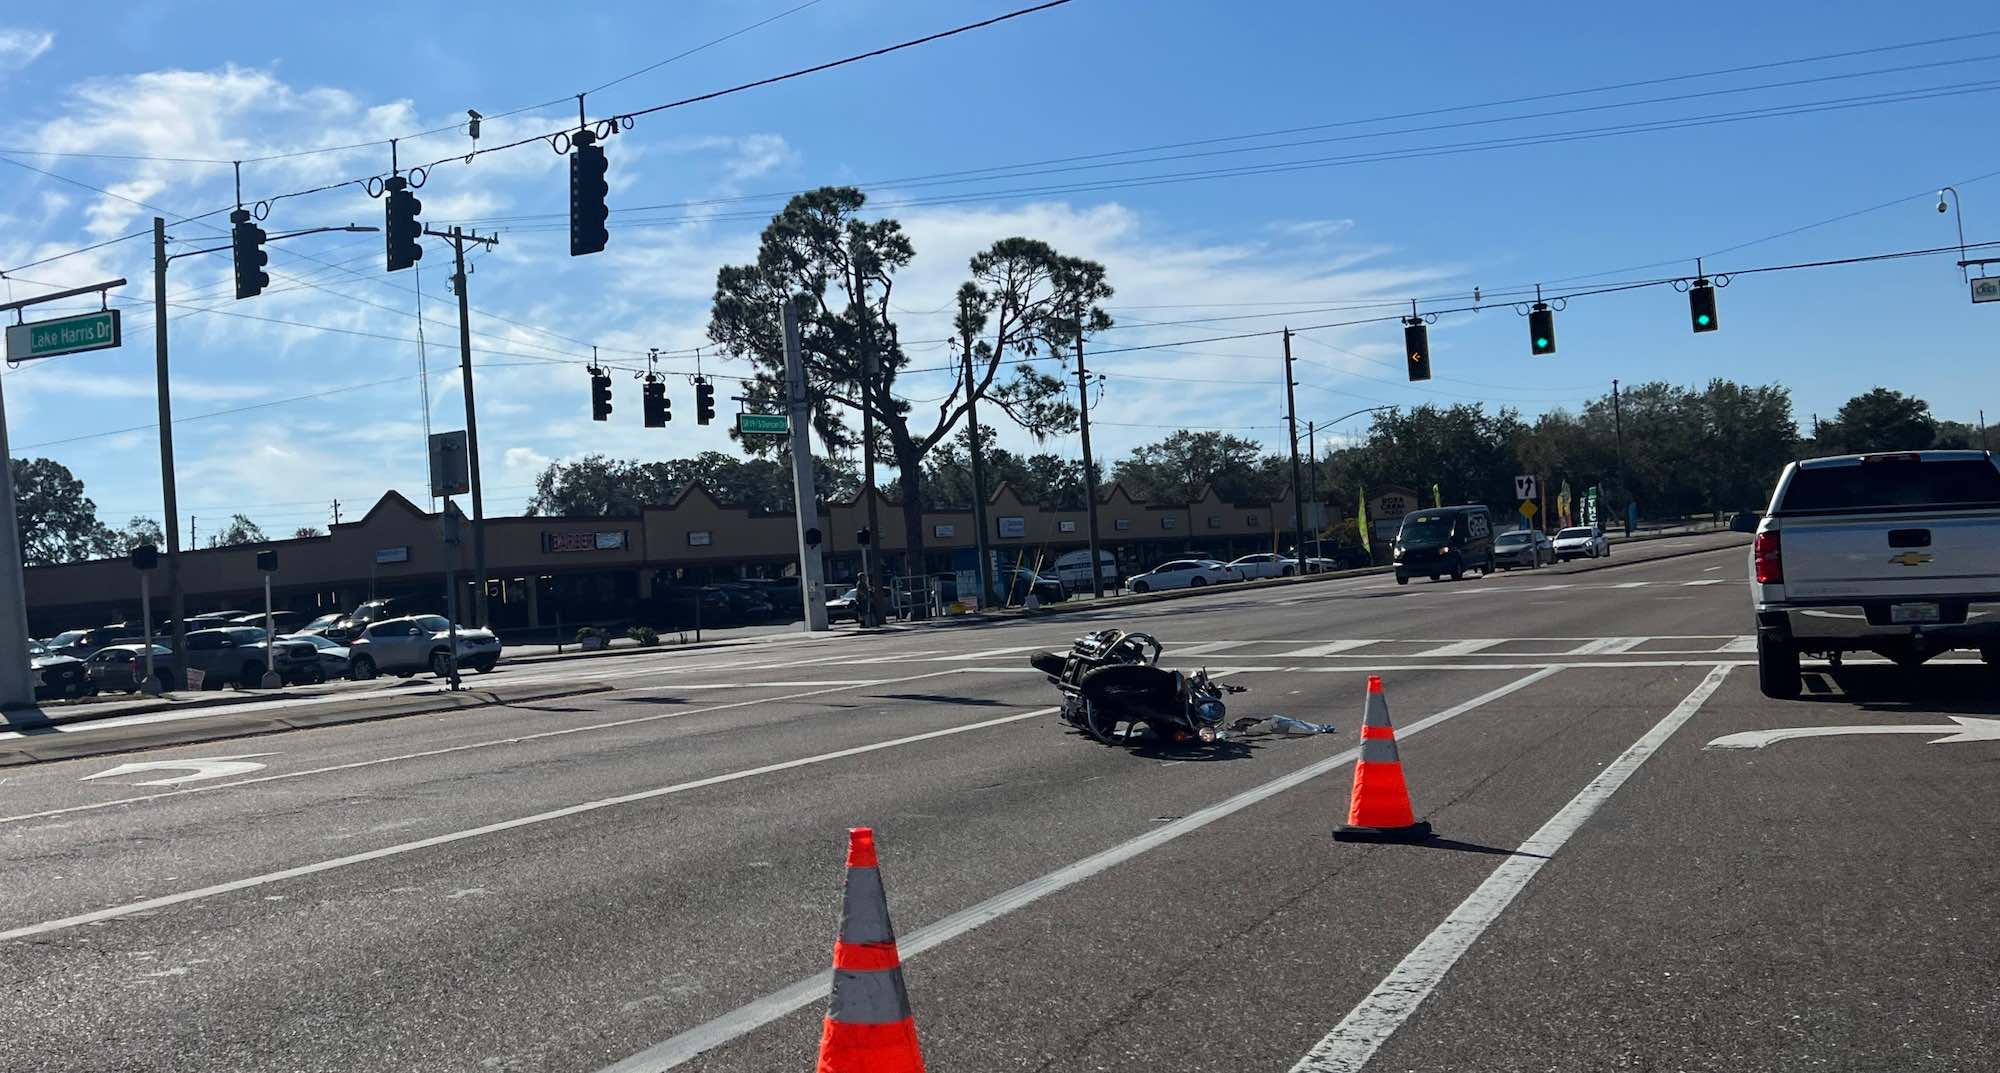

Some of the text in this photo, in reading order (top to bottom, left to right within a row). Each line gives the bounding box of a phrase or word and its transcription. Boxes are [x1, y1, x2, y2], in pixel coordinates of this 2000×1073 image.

[31, 321, 111, 348] Lake Harris Dr
